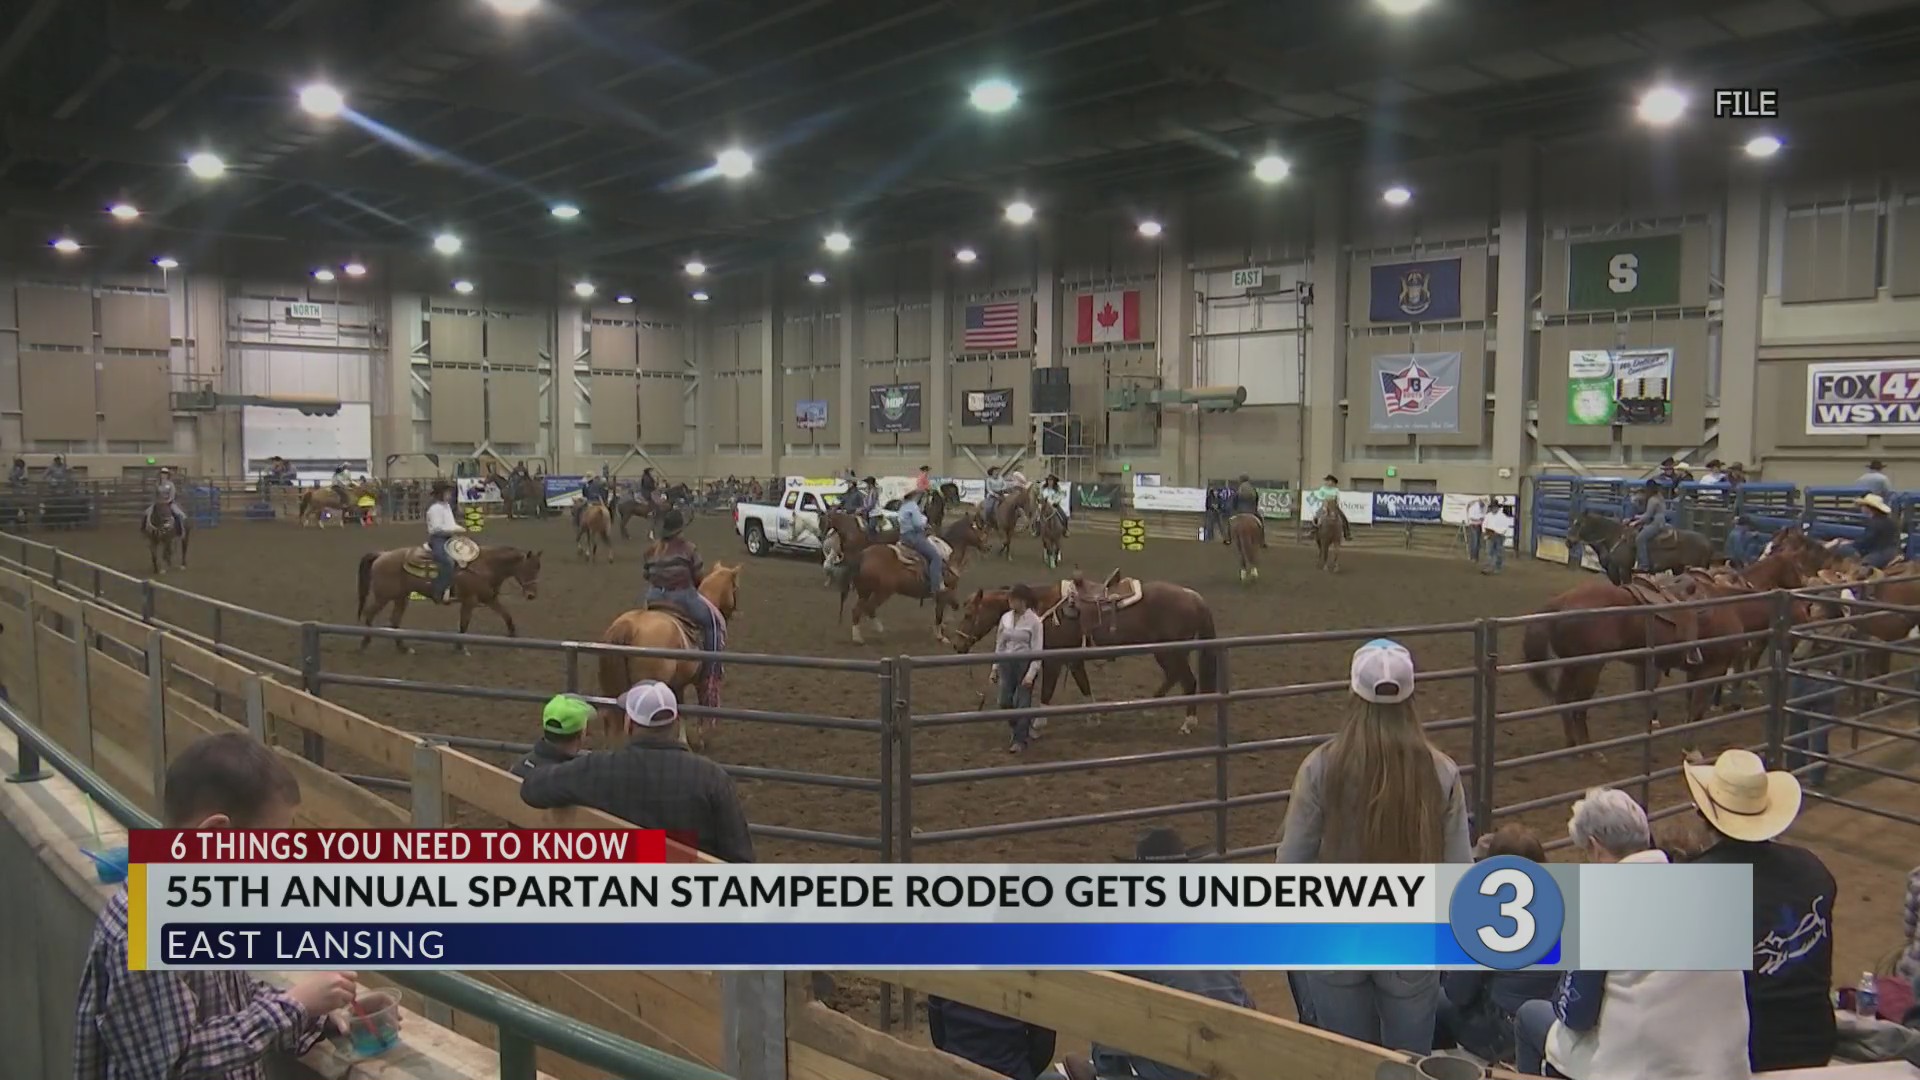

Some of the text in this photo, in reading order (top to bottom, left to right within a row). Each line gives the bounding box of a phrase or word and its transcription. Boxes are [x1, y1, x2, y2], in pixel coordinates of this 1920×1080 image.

[1234, 270, 1260, 286] EAST
[1608, 253, 1639, 293] S
[292, 303, 320, 316] NORTH
[1818, 374, 1877, 400] FOX
[1817, 403, 1920, 423] WSYM
[1376, 493, 1440, 506] MONTANA
